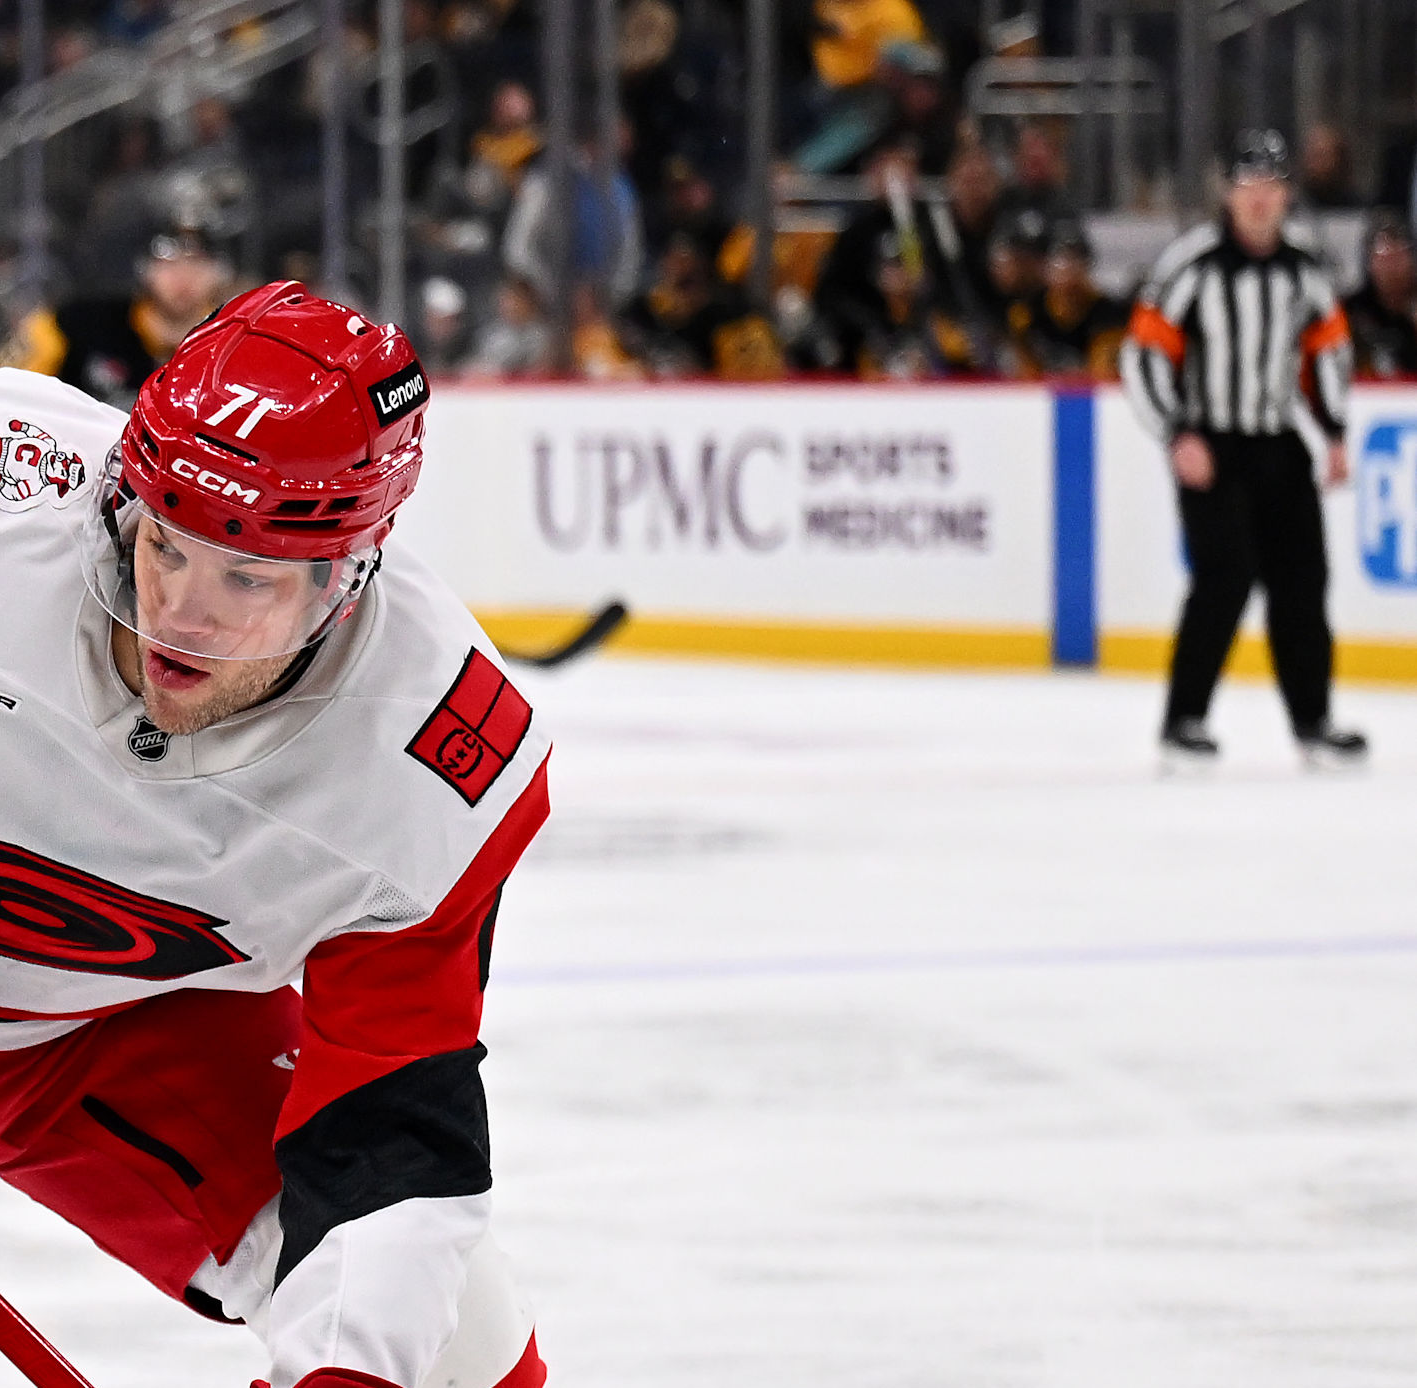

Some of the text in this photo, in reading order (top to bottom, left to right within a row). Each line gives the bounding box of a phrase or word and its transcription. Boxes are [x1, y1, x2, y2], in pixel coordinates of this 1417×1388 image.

[207, 383, 274, 440] 71
[376, 373, 424, 415] Lenovo
[170, 457, 261, 505] CCM
[800, 430, 956, 482] SPORTS
[529, 428, 789, 554] UPMC
[800, 502, 989, 552] MEDICINE
[134, 733, 165, 749] NHL
